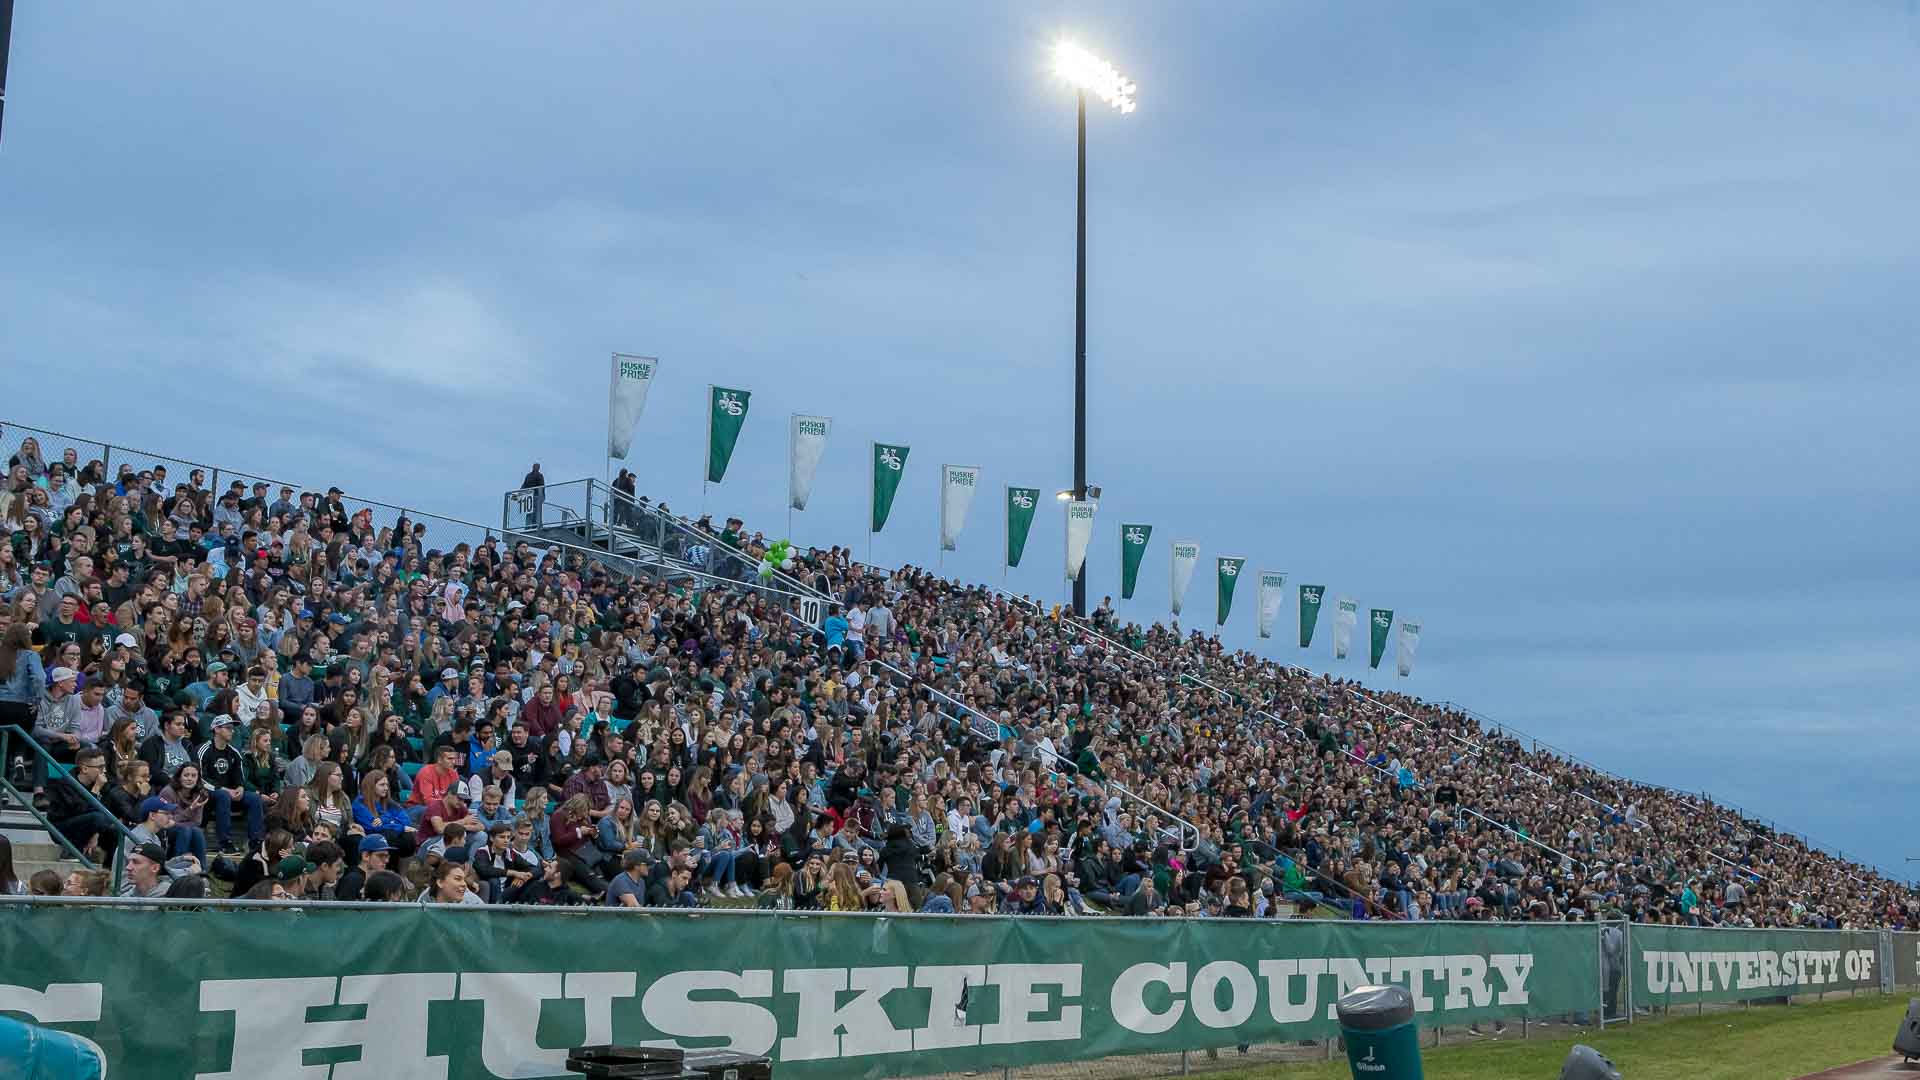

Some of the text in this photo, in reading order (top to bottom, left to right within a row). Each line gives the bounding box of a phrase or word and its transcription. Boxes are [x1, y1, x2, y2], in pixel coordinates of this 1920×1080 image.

[620, 360, 650, 371] HUSKIE
[620, 368, 650, 380] PRIDE
[800, 420, 825, 429] HUSKIE
[800, 426, 825, 436] PRIDE
[950, 471, 974, 479] HUSKIE
[950, 477, 974, 486] PRIDE
[518, 495, 533, 515] 110
[1071, 511, 1093, 519] PRIDE
[803, 600, 819, 625] 10
[1643, 950, 1841, 994] UNIVERSITY
[1845, 950, 1875, 981] OF
[195, 963, 1083, 1080] HUSKIE
[1111, 954, 1534, 1034] COUNTRY
